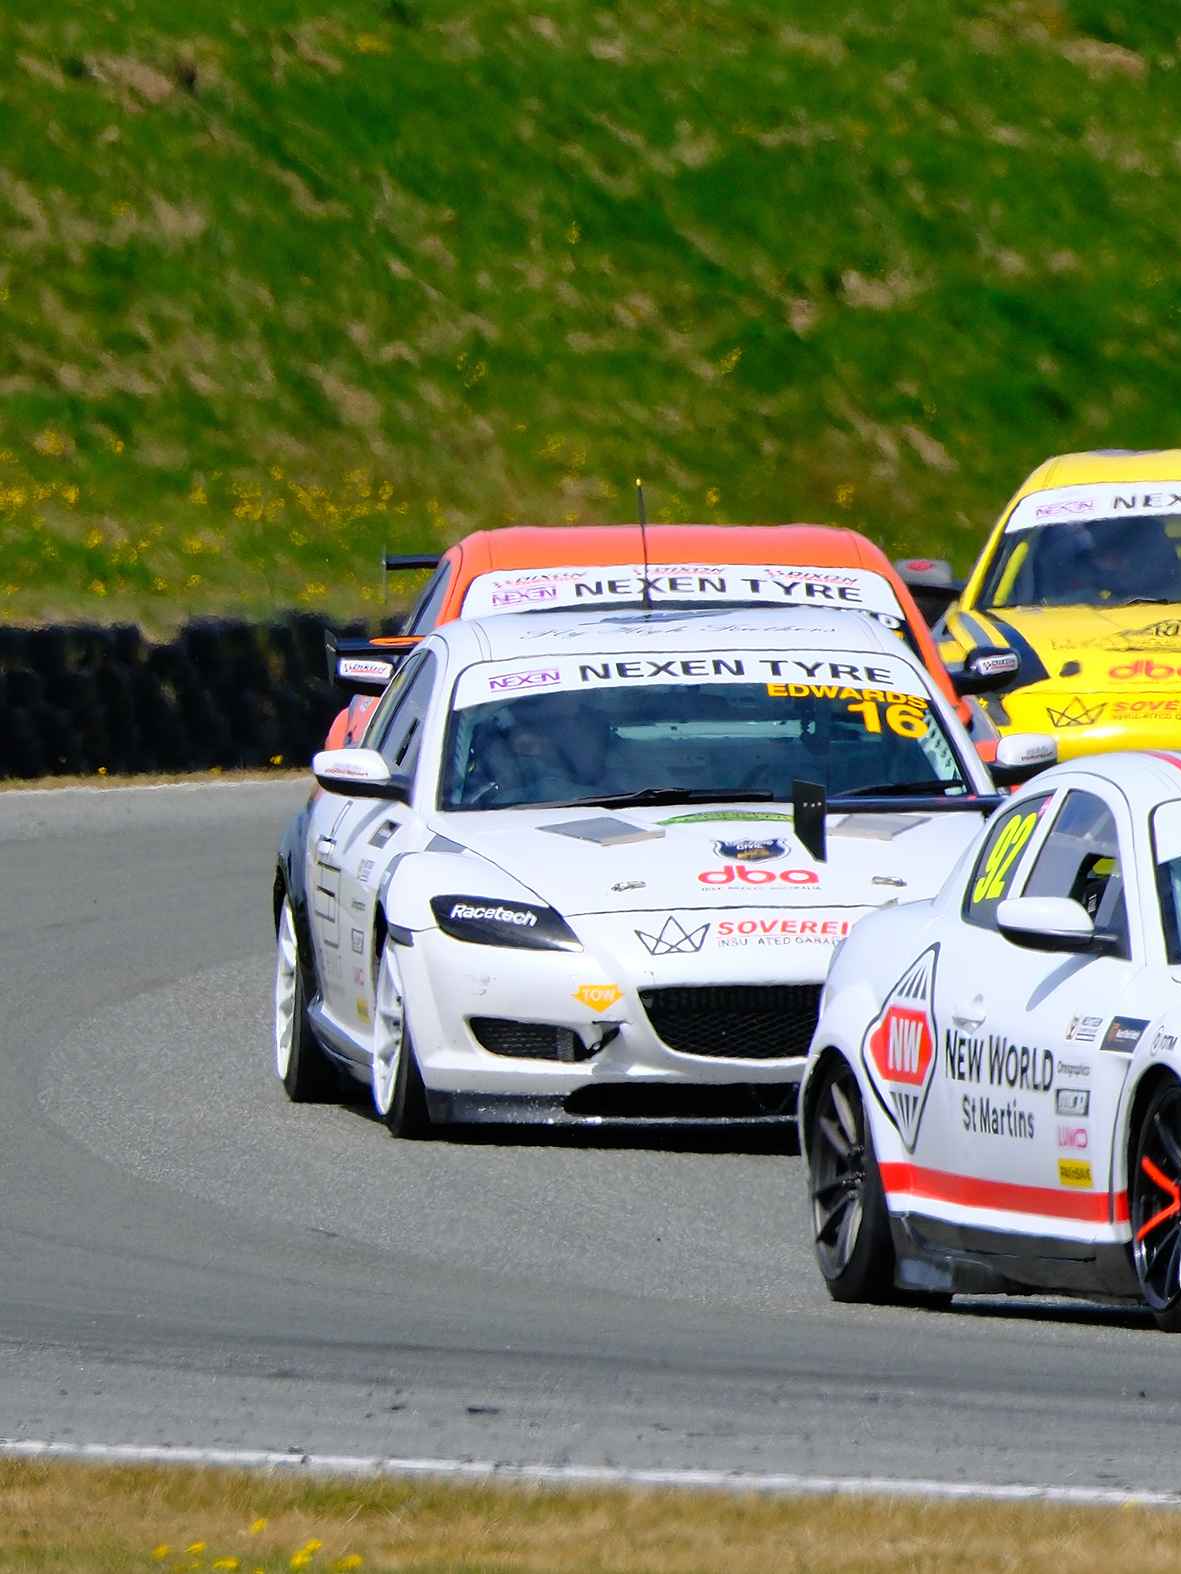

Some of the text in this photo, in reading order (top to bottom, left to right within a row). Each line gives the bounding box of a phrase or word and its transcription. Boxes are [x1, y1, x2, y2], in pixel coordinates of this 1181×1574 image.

[491, 587, 557, 606] NEXEN
[574, 576, 864, 603] NEXEN TYRE
[488, 670, 561, 692] NEXEN
[578, 659, 895, 686] NEXEN TYRE
[766, 682, 929, 710] EDWARDS
[847, 701, 929, 739] 16
[972, 812, 1038, 904] 92
[697, 864, 820, 884] dba
[450, 903, 538, 928] Racetech
[718, 936, 792, 948] INSUATED
[582, 989, 616, 1001] TOW
[887, 1016, 924, 1074] NW
[945, 1028, 1055, 1092] NEW WORLD
[962, 1094, 977, 1133] St
[980, 1096, 1035, 1139] Martins
